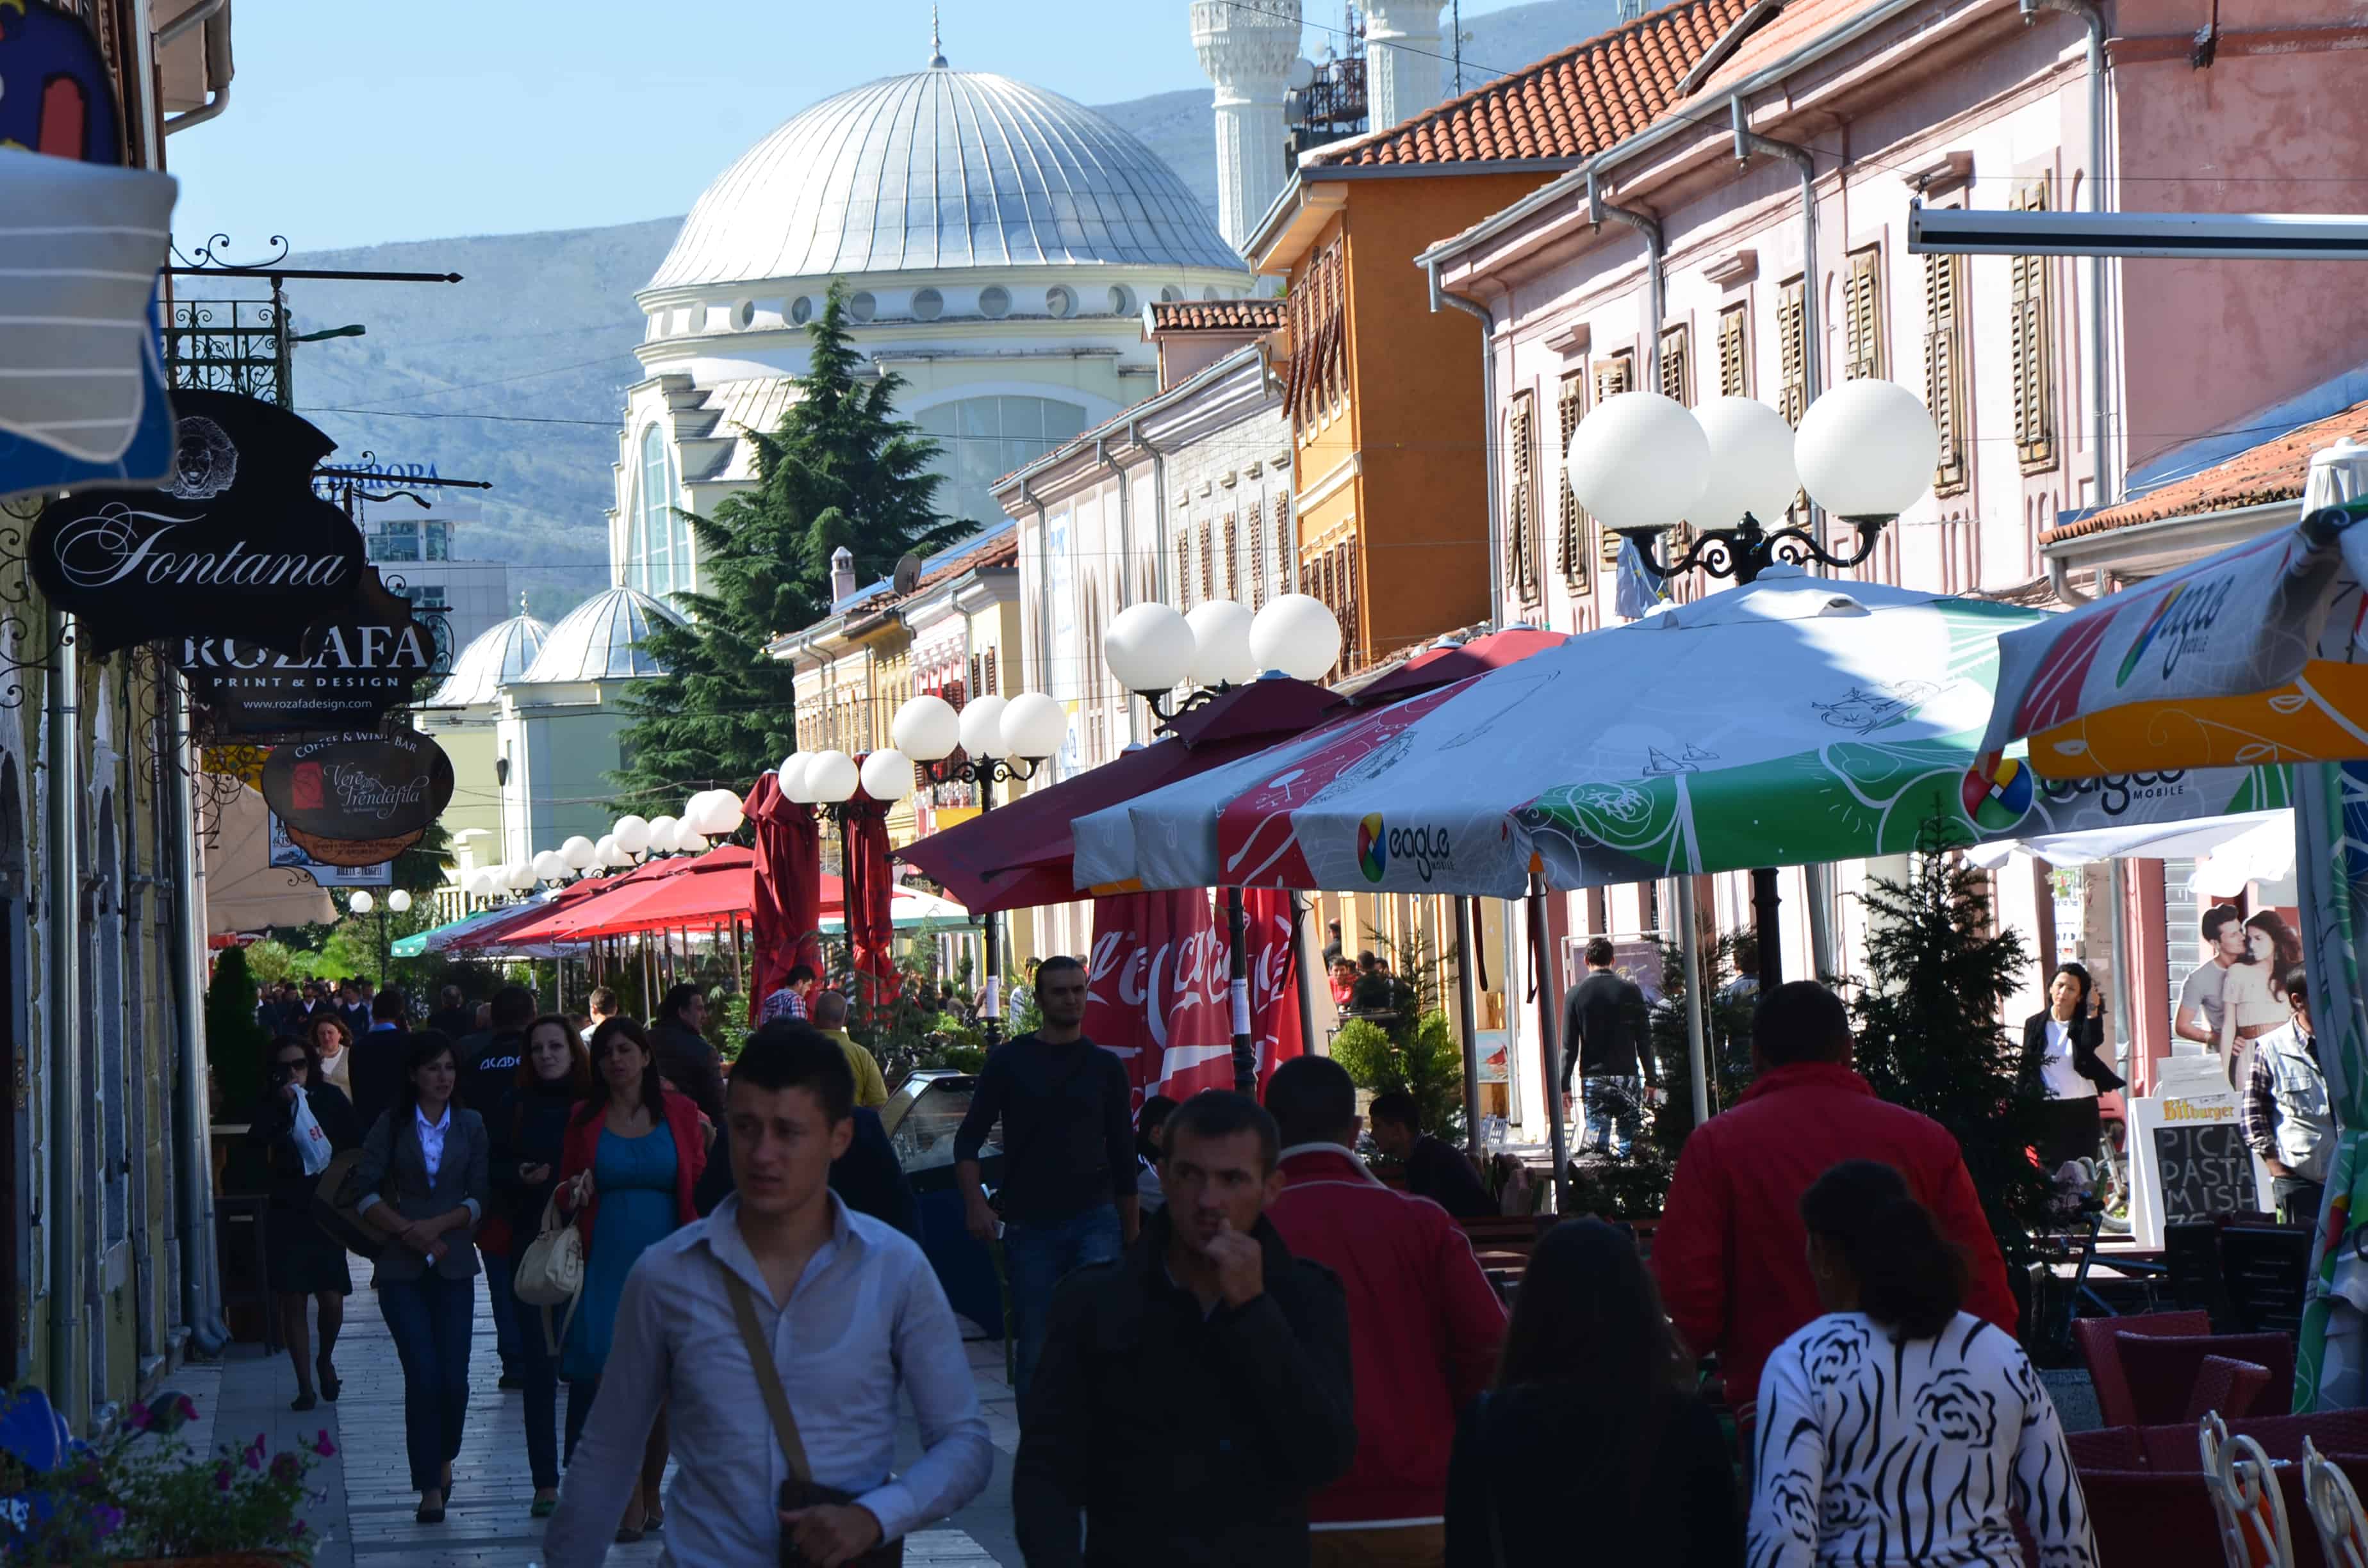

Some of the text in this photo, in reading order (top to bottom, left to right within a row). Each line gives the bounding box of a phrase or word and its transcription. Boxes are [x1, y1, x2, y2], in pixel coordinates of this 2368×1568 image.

[55, 502, 347, 587] Fontana
[213, 676, 399, 687] PRINT & DESIGN
[243, 698, 372, 712] www.rozafadesign.com
[342, 731, 354, 742] &
[394, 735, 418, 753] BAR
[2133, 785, 2184, 800] MOBILE
[1389, 824, 1450, 883] eagle
[1431, 861, 1456, 871] MOBILE
[2162, 1099, 2235, 1122] Bitburger
[2158, 1127, 2246, 1157] PICA
[2160, 1157, 2256, 1189] PASTA
[2163, 1186, 2257, 1213] MISH
